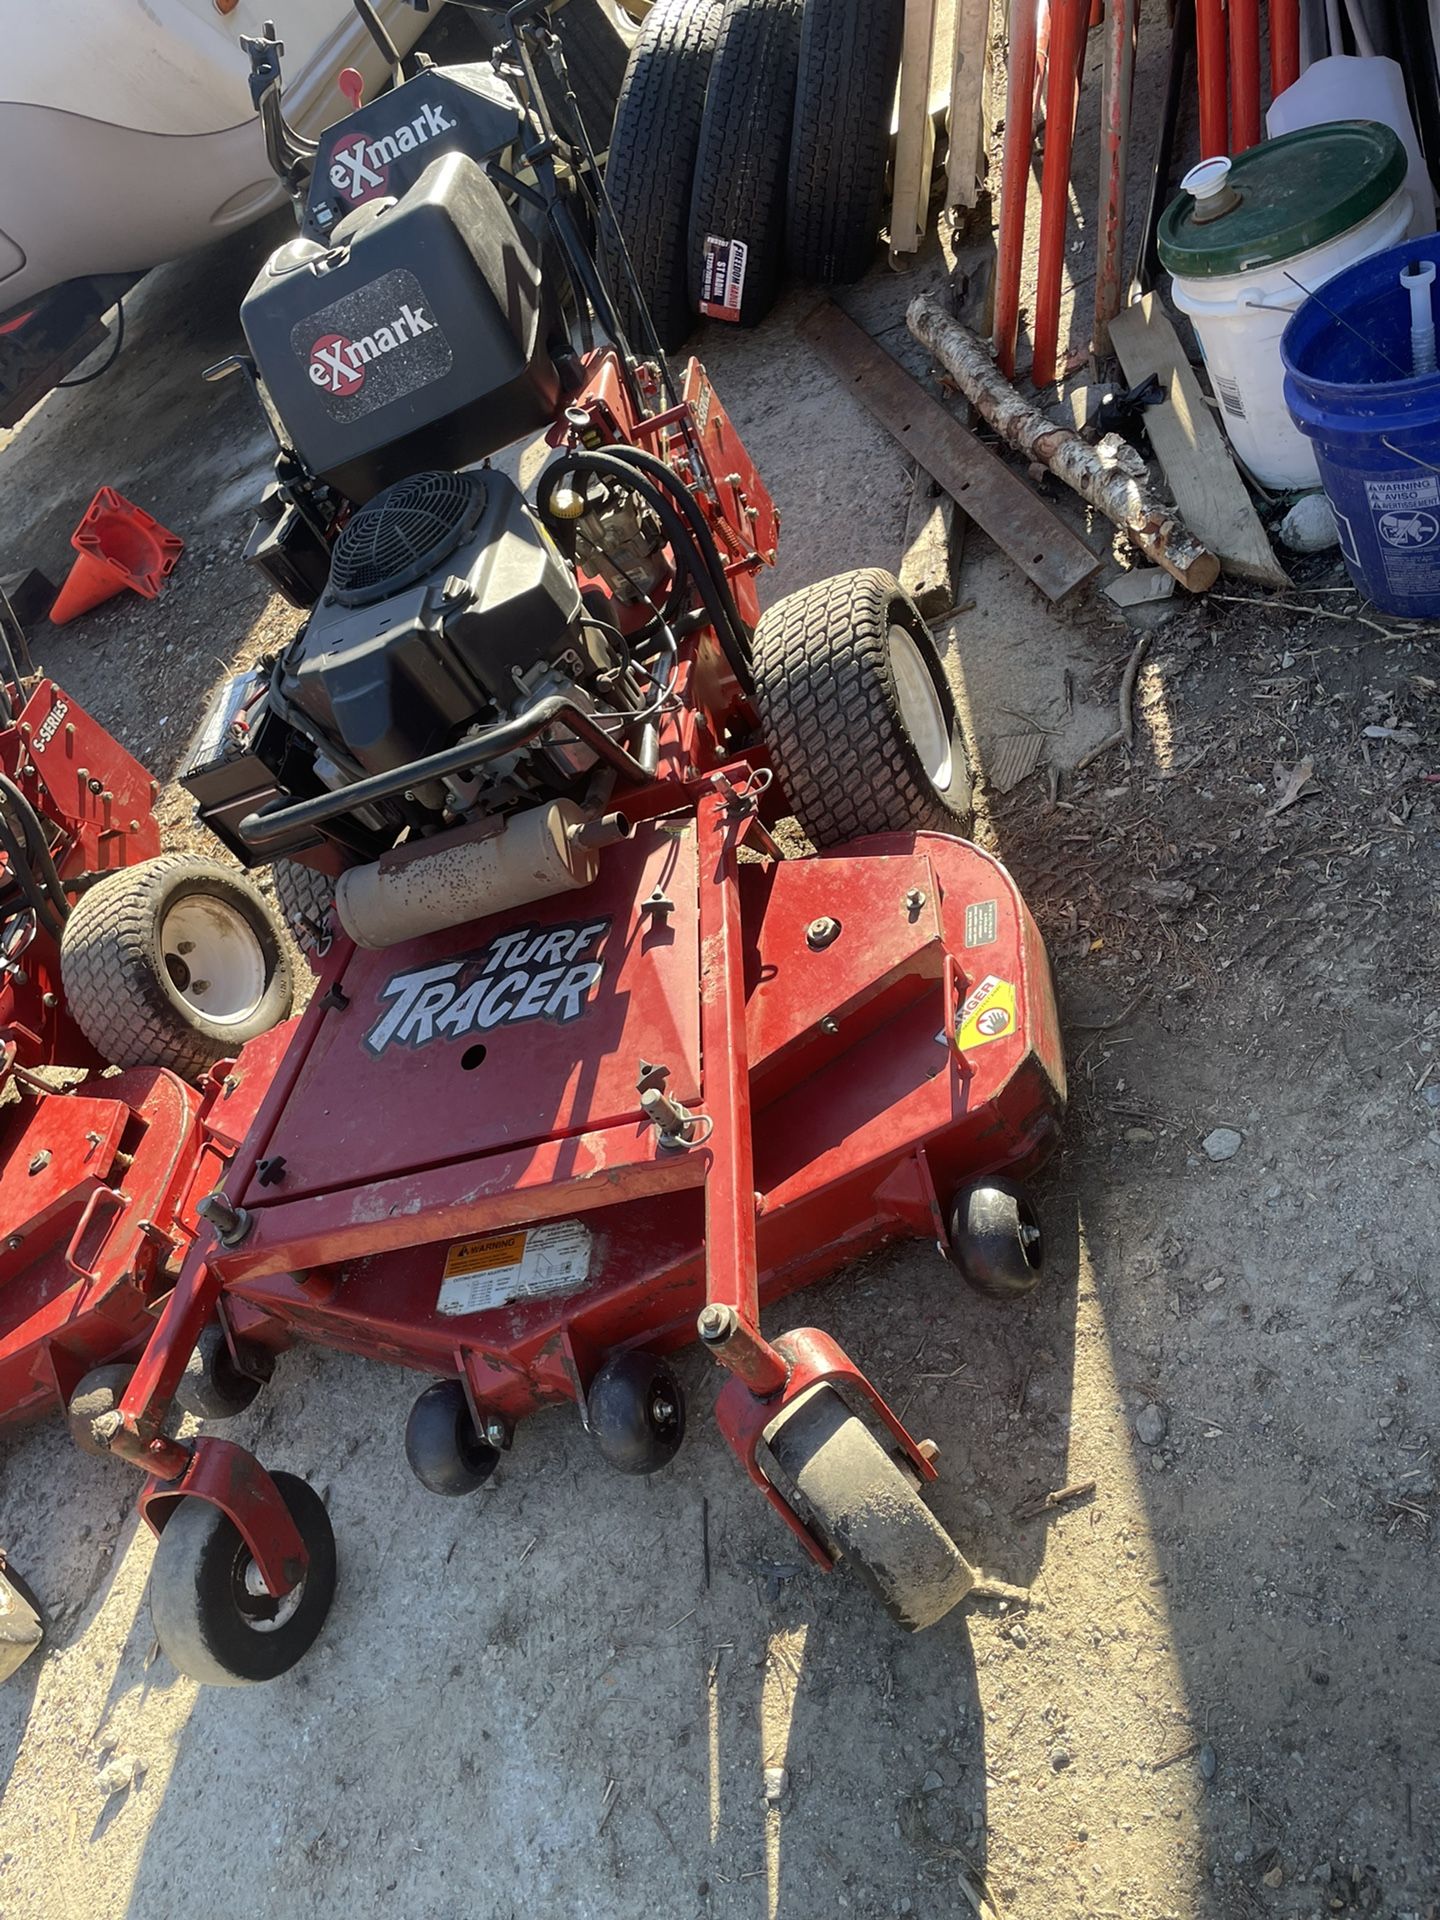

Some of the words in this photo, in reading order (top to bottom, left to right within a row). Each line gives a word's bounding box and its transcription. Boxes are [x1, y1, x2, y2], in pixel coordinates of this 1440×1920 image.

[329, 103, 452, 198] eXmark
[714, 272, 725, 297] RADIAL
[716, 261, 726, 273] ST
[732, 242, 744, 285] FREEDOM
[309, 304, 434, 391] eXmark
[1376, 480, 1430, 491] WARNING
[1381, 498, 1438, 509] AVERTISSEMENT
[1385, 492, 1418, 500] AVISO
[33, 700, 68, 753] S-SERIES
[482, 922, 608, 975] TURF
[368, 961, 604, 1052] TRACER
[942, 981, 994, 1037] ANGER
[470, 1238, 515, 1255] WARNING
